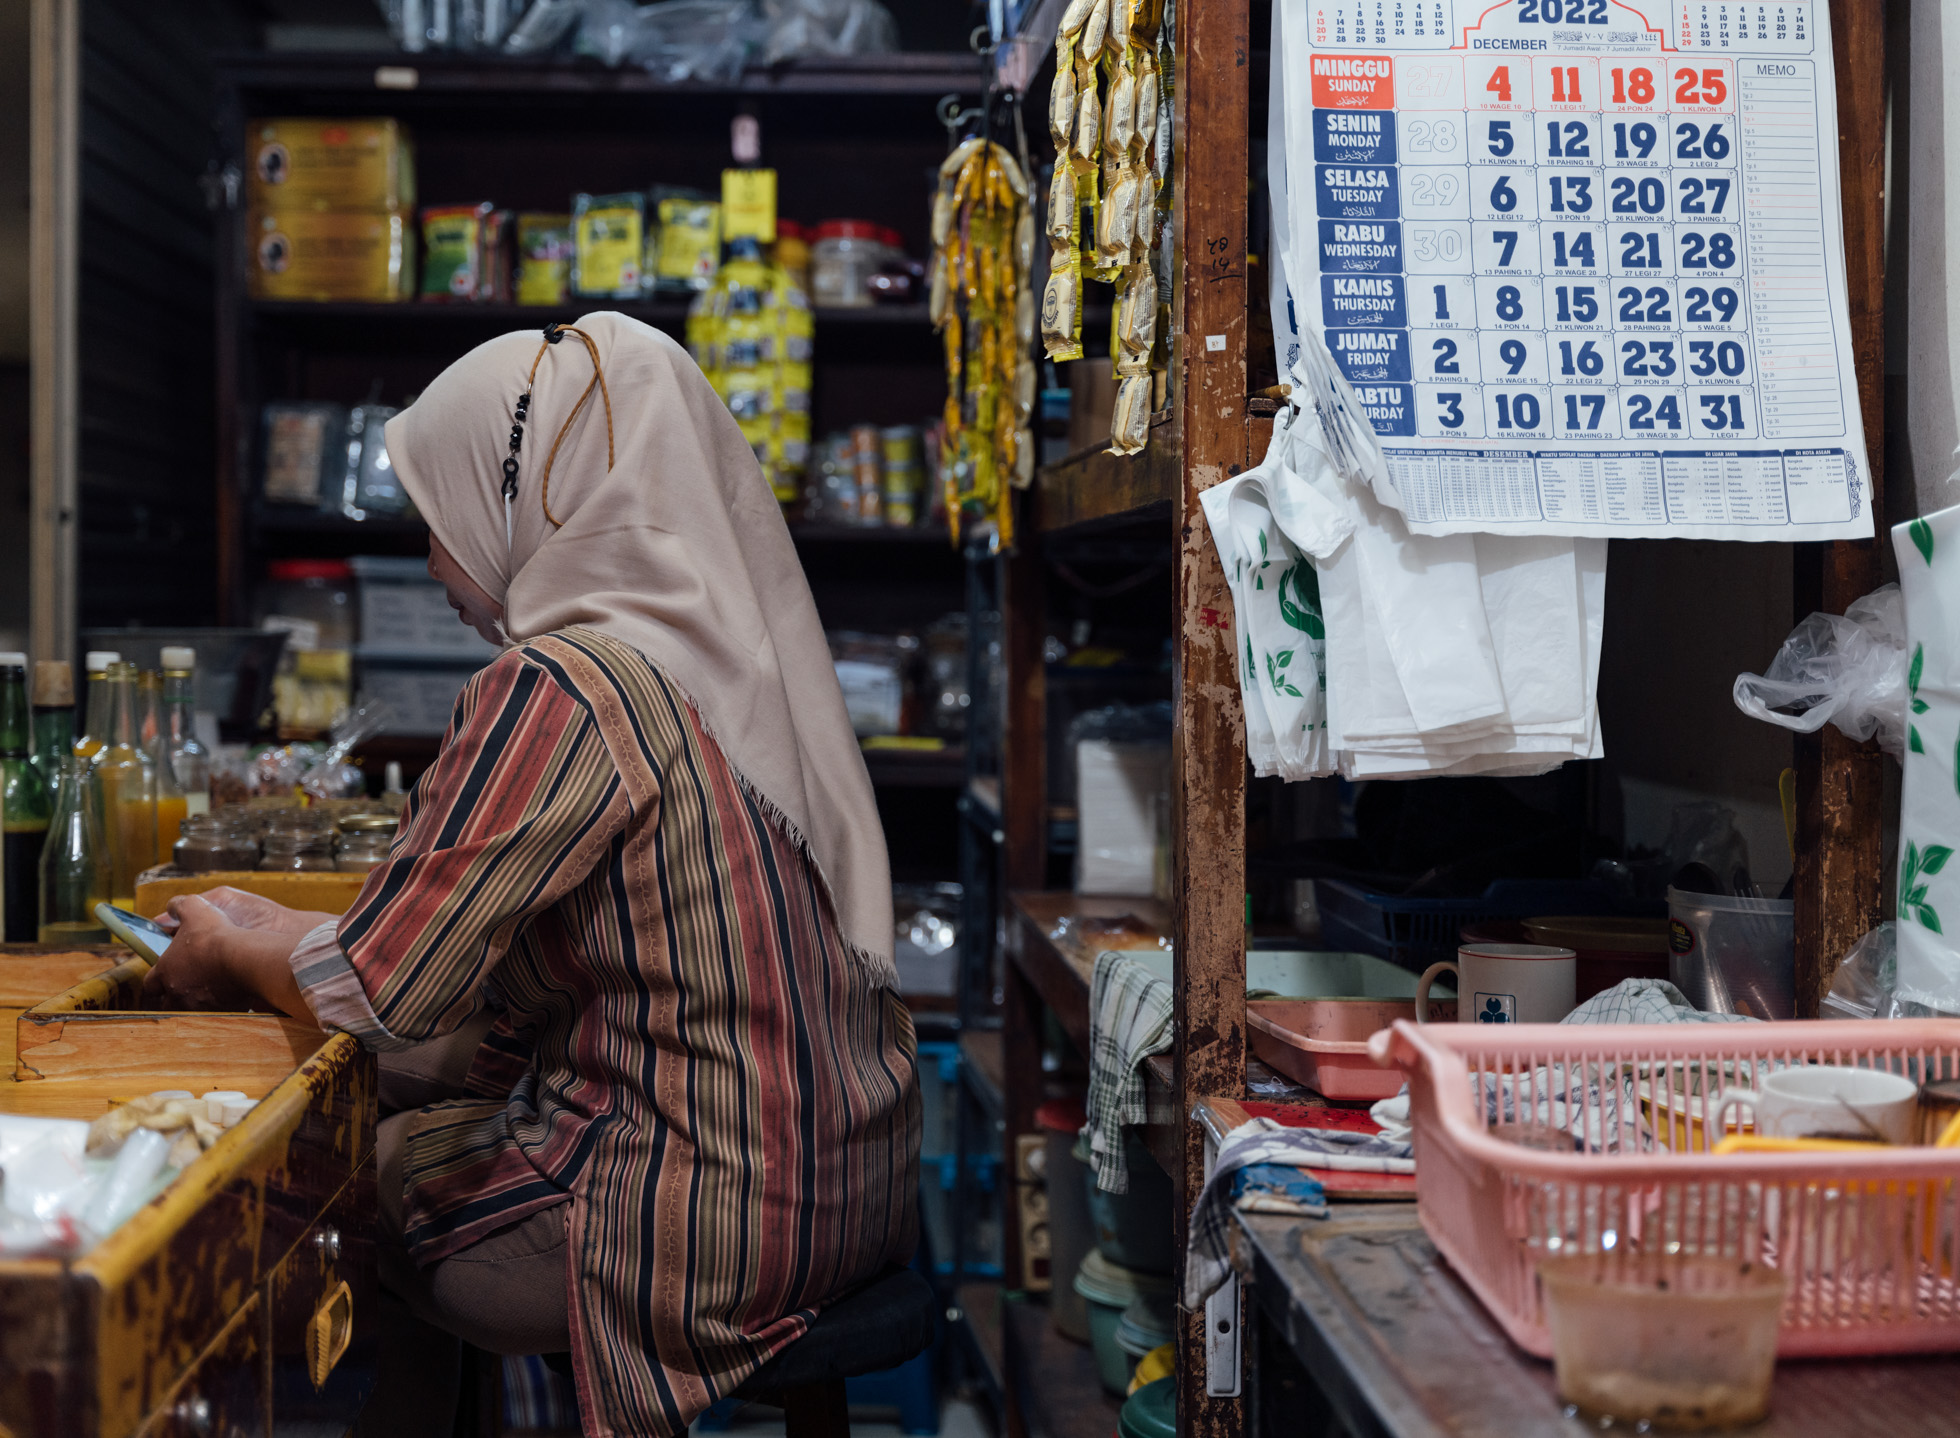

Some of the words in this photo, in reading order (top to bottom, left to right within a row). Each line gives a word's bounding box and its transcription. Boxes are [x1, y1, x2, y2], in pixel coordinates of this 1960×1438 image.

[1518, 0, 1608, 24] 2022
[1316, 34, 1326, 42] 27
[1376, 28, 1386, 36] 23
[1700, 30, 1710, 38] 23
[1758, 32, 1768, 40] 26
[1796, 32, 1806, 40] 28
[1473, 38, 1548, 50] DECEMBER
[1312, 57, 1391, 78] MINGGU
[1756, 64, 1796, 76] MEMO
[1328, 78, 1377, 93] SUNDAY
[1407, 65, 1452, 97] 27
[1487, 66, 1511, 101] 4
[1551, 67, 1582, 102] 11
[1611, 68, 1655, 104] 18
[1675, 68, 1727, 105] 25
[1327, 113, 1381, 133] SENIN
[1328, 133, 1382, 148] MONDAY
[1408, 120, 1457, 153] 28
[1488, 121, 1514, 157] 5
[1548, 121, 1589, 157] 12
[1614, 122, 1656, 158] 19
[1676, 123, 1729, 160] 26
[1324, 168, 1390, 188] SELASA
[1331, 188, 1384, 203] TUESDAY
[1411, 174, 1459, 206] 29
[1490, 176, 1517, 212] 6
[1549, 177, 1592, 213] 13
[1611, 177, 1665, 214] 20
[1679, 178, 1730, 214] 27
[1334, 224, 1385, 243] RABU
[1324, 243, 1397, 257] WEDNESDAY
[1414, 229, 1462, 261] 30
[1493, 231, 1518, 266] 7
[1553, 232, 1595, 267] 14
[1620, 232, 1662, 268] 21
[1681, 233, 1735, 269] 28
[1333, 278, 1394, 297] KAMIS
[1332, 297, 1396, 311] THURSDAY
[1434, 285, 1449, 319] 1
[1496, 285, 1523, 321] 8
[1556, 286, 1598, 322] 15
[1618, 287, 1671, 322] 22
[1685, 287, 1738, 322] 29
[1336, 333, 1399, 351] JUMAT
[1347, 352, 1390, 365] FRIDAY
[1433, 338, 1459, 374] 2
[1500, 340, 1526, 375] 9
[1559, 341, 1603, 376] 16
[1622, 341, 1676, 377] 23
[1689, 341, 1745, 376] 30
[1355, 387, 1402, 405] ABTU
[1365, 406, 1404, 420] URDAY
[1437, 393, 1464, 428] 3
[1496, 393, 1540, 429] 10
[1565, 395, 1605, 429] 17
[1627, 394, 1681, 429] 24
[1700, 395, 1744, 430] 31
